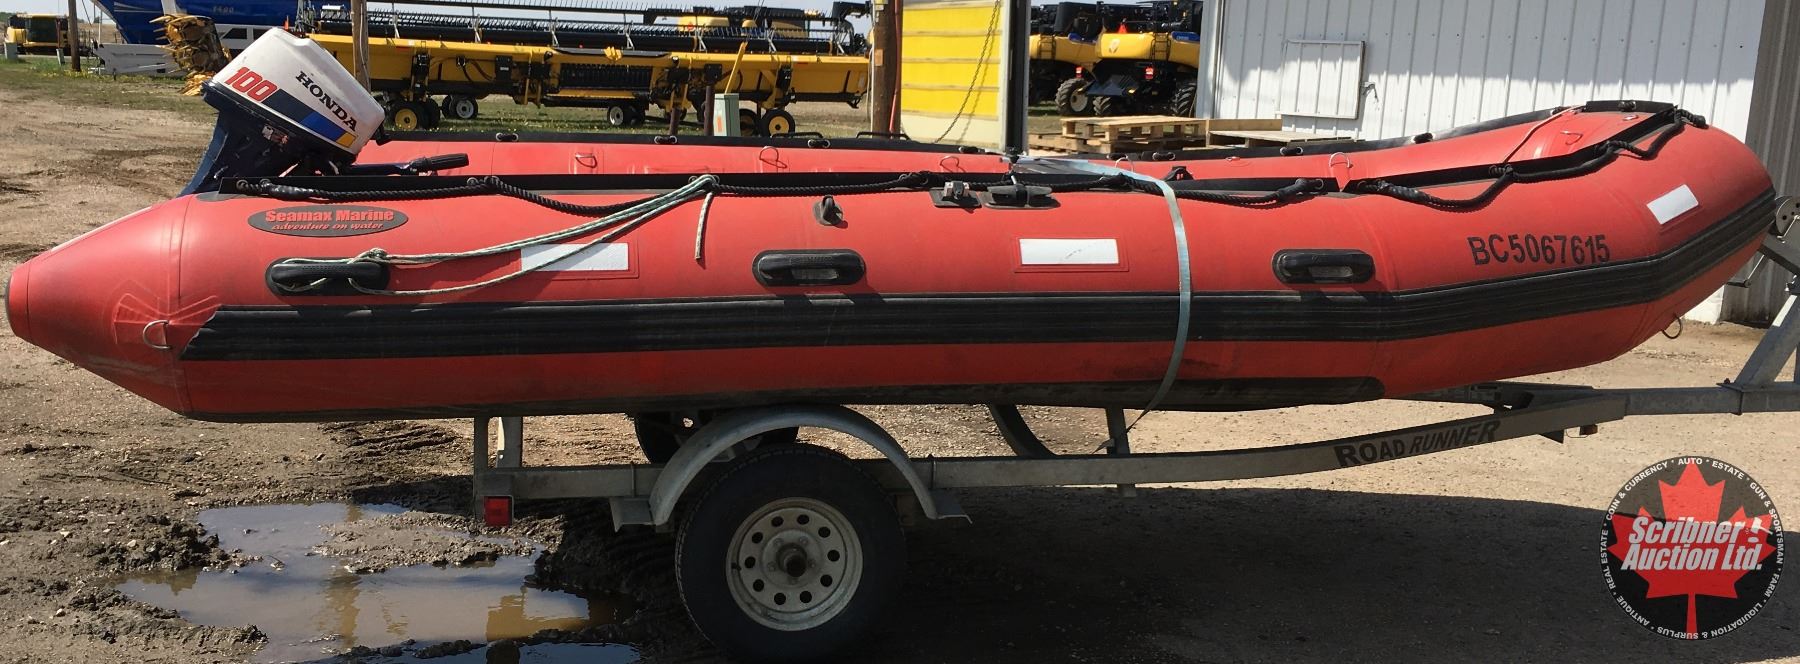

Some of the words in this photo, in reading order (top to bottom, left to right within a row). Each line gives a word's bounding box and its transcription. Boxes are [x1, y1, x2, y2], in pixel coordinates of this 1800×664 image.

[225, 66, 278, 102] 100
[295, 70, 357, 132] HONDA
[265, 209, 332, 222] Seamax
[335, 209, 394, 222] Marine
[272, 222, 329, 230] adventure
[350, 223, 384, 231] water
[1467, 233, 1610, 266] BC5067615
[1333, 442, 1405, 469] ROAD
[1409, 420, 1501, 454] RUNNER
